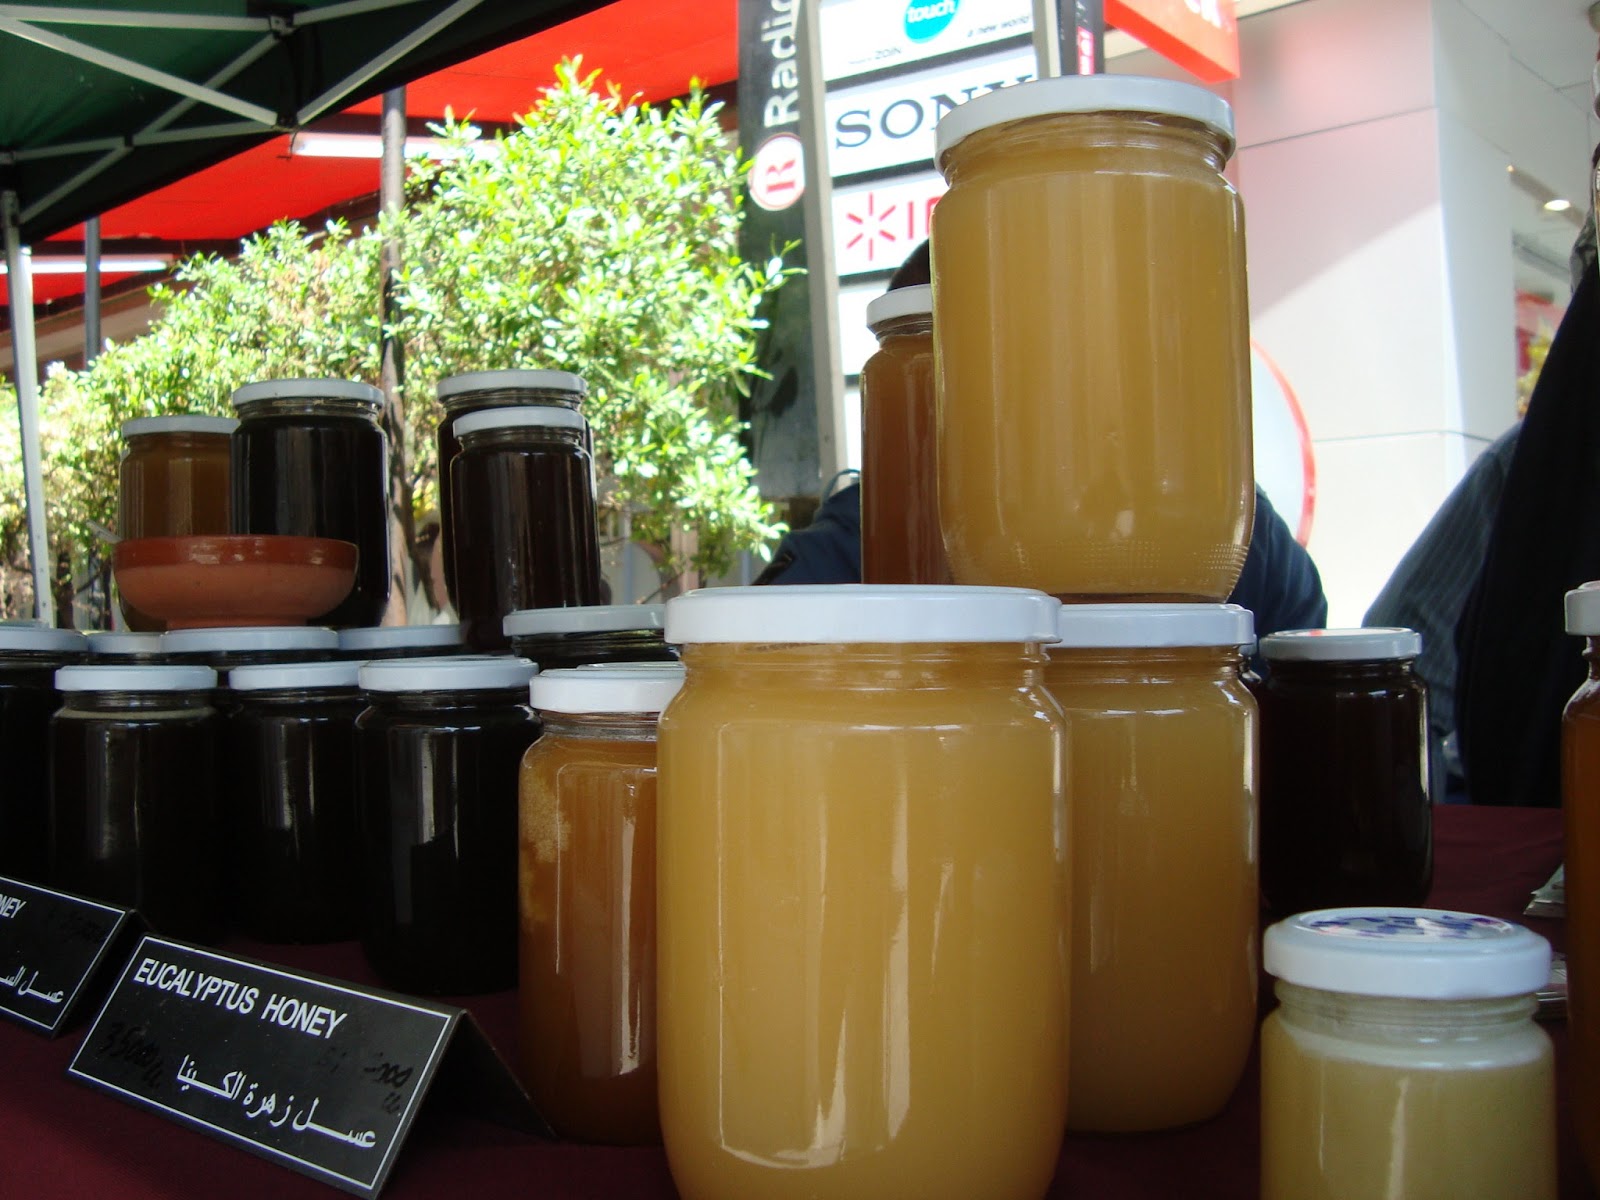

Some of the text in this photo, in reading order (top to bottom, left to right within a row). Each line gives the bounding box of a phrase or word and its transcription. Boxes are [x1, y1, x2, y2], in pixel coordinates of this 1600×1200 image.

[905, 0, 957, 23] touch
[835, 74, 1033, 150] SON
[17, 970, 64, 1003] عسل
[133, 957, 348, 1039] EUCALYPTUS HONEY
[243, 1082, 295, 1128] زهرة
[292, 1097, 376, 1148] عسل
